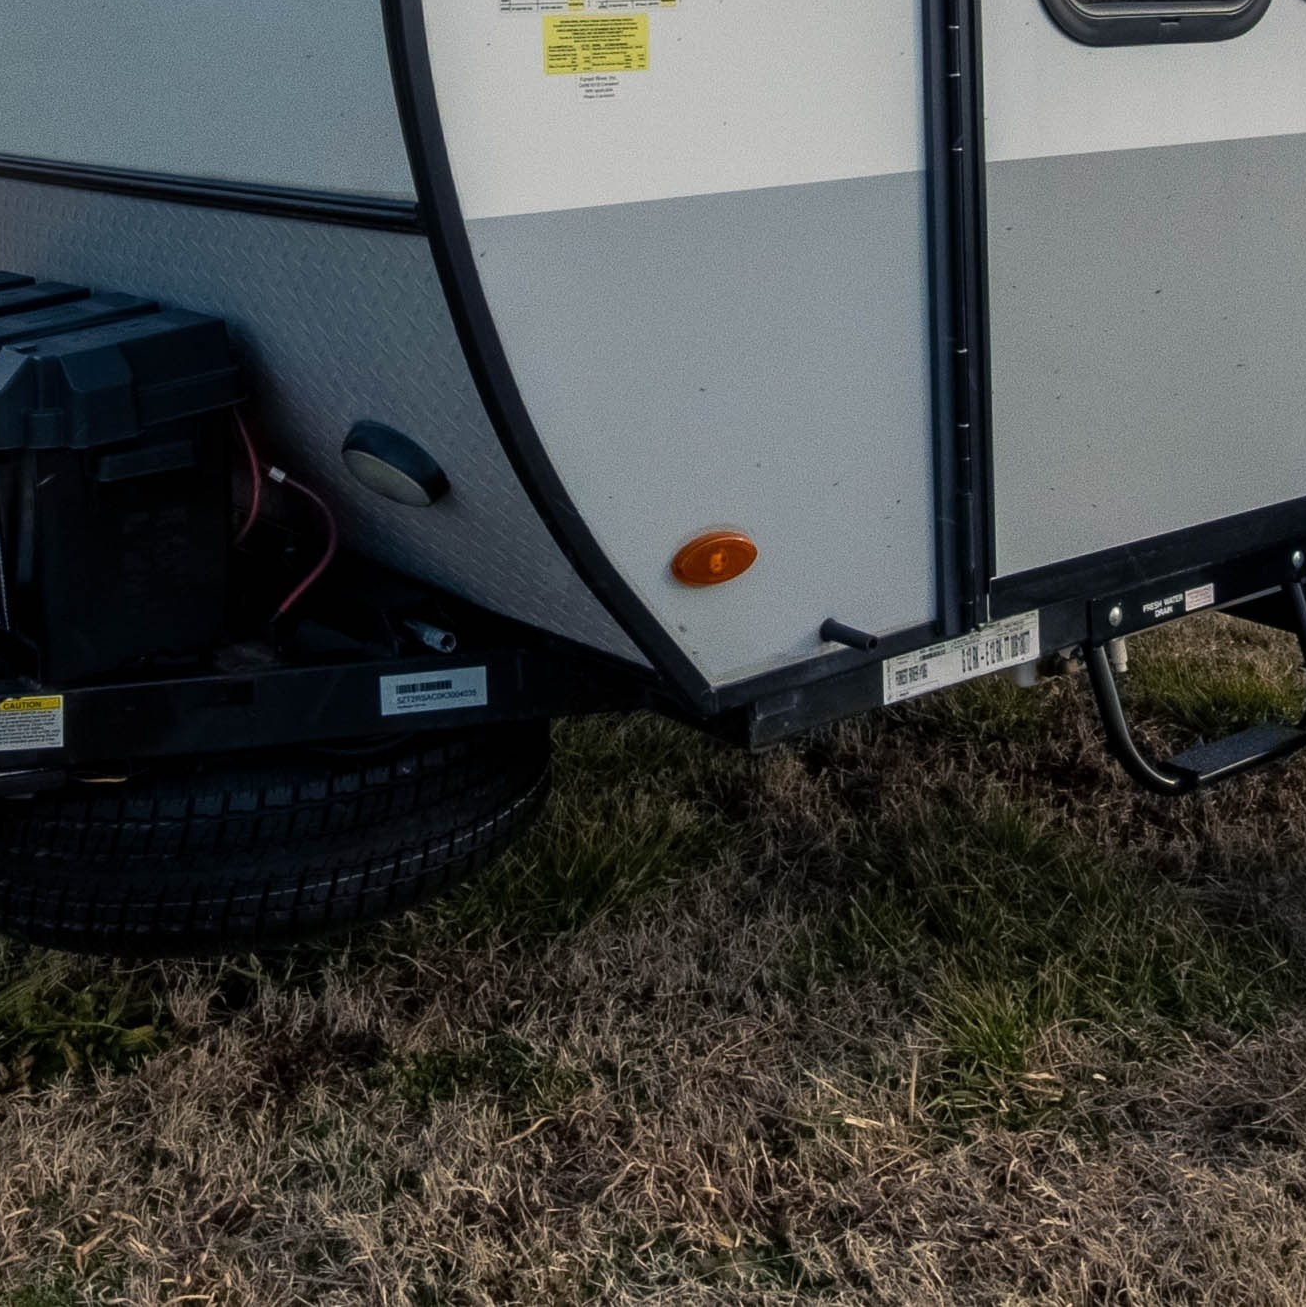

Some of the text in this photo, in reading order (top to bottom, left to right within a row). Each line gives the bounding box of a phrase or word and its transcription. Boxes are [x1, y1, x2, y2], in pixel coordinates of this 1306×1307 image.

[1142, 599, 1163, 613] FRESH
[1164, 594, 1183, 605] WATER
[1154, 605, 1173, 618] DRAIN
[3, 701, 42, 709] CAUTION
